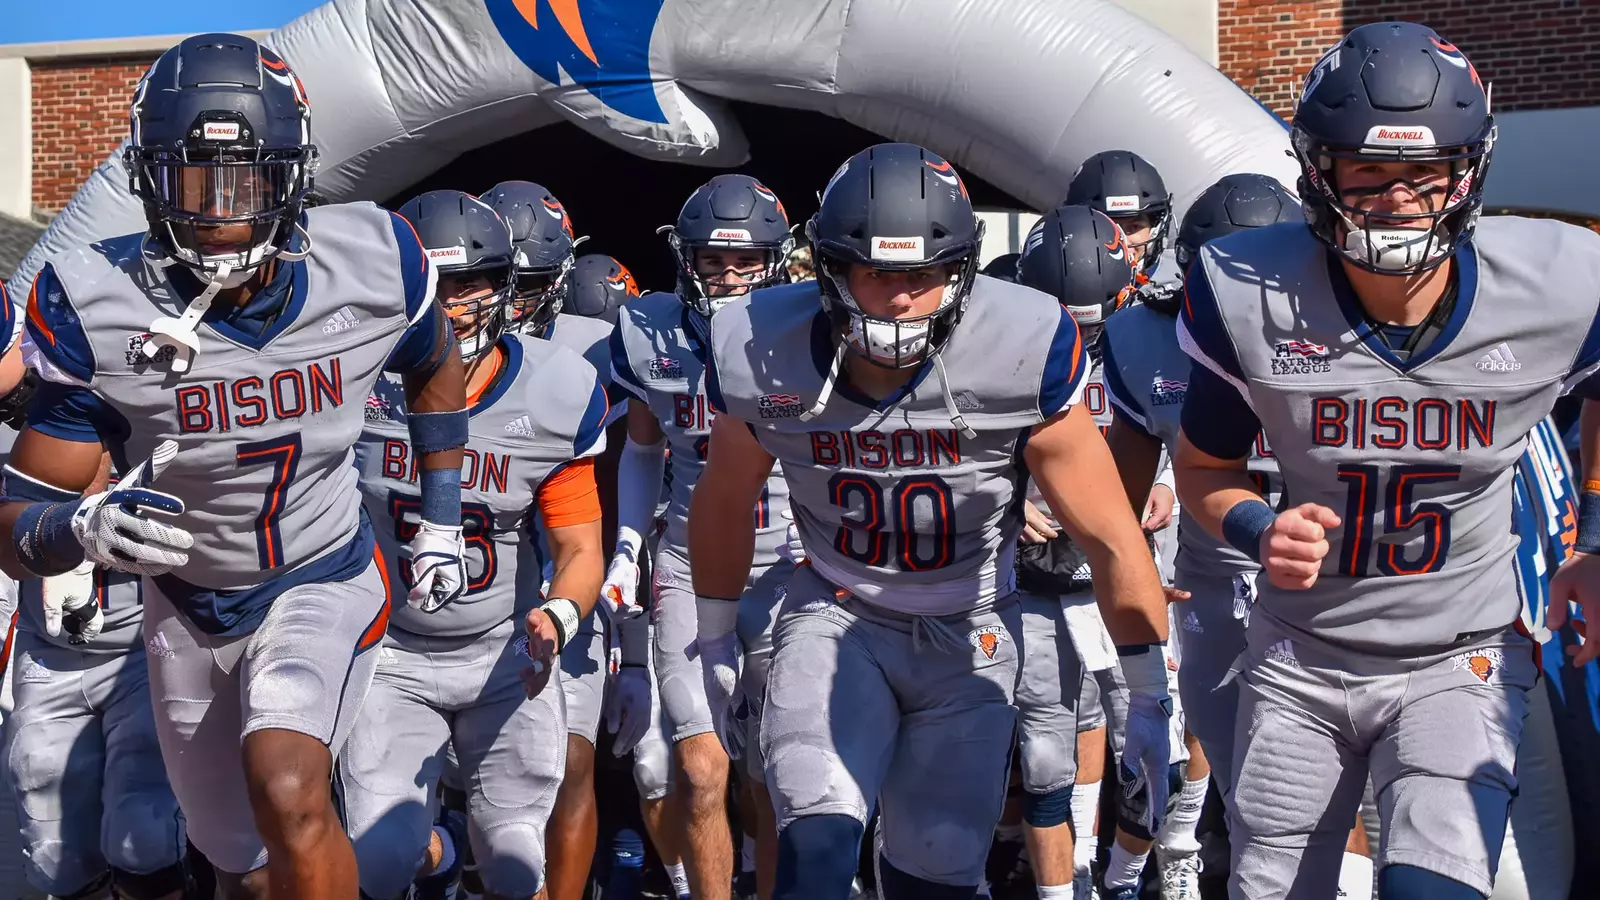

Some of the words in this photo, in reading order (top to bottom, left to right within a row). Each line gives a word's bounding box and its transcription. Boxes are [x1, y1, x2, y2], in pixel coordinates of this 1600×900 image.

[207, 126, 237, 135] BUCKNELL
[1377, 128, 1424, 140] BUCKNELL
[717, 231, 744, 239] BUCKNELL
[878, 240, 916, 249] BUCKNELL
[322, 318, 360, 334] adidas
[1271, 356, 1329, 367] PATRIOT
[1475, 360, 1522, 371] adidas
[1271, 364, 1332, 375] LEAGUE
[175, 357, 343, 434] BISON
[757, 402, 806, 413] PATRIOT
[1312, 396, 1497, 451] BISON
[505, 424, 536, 437] adidas
[811, 428, 961, 468] BISON
[236, 431, 303, 571] 7
[827, 472, 956, 573] 30
[1337, 464, 1462, 577] 15
